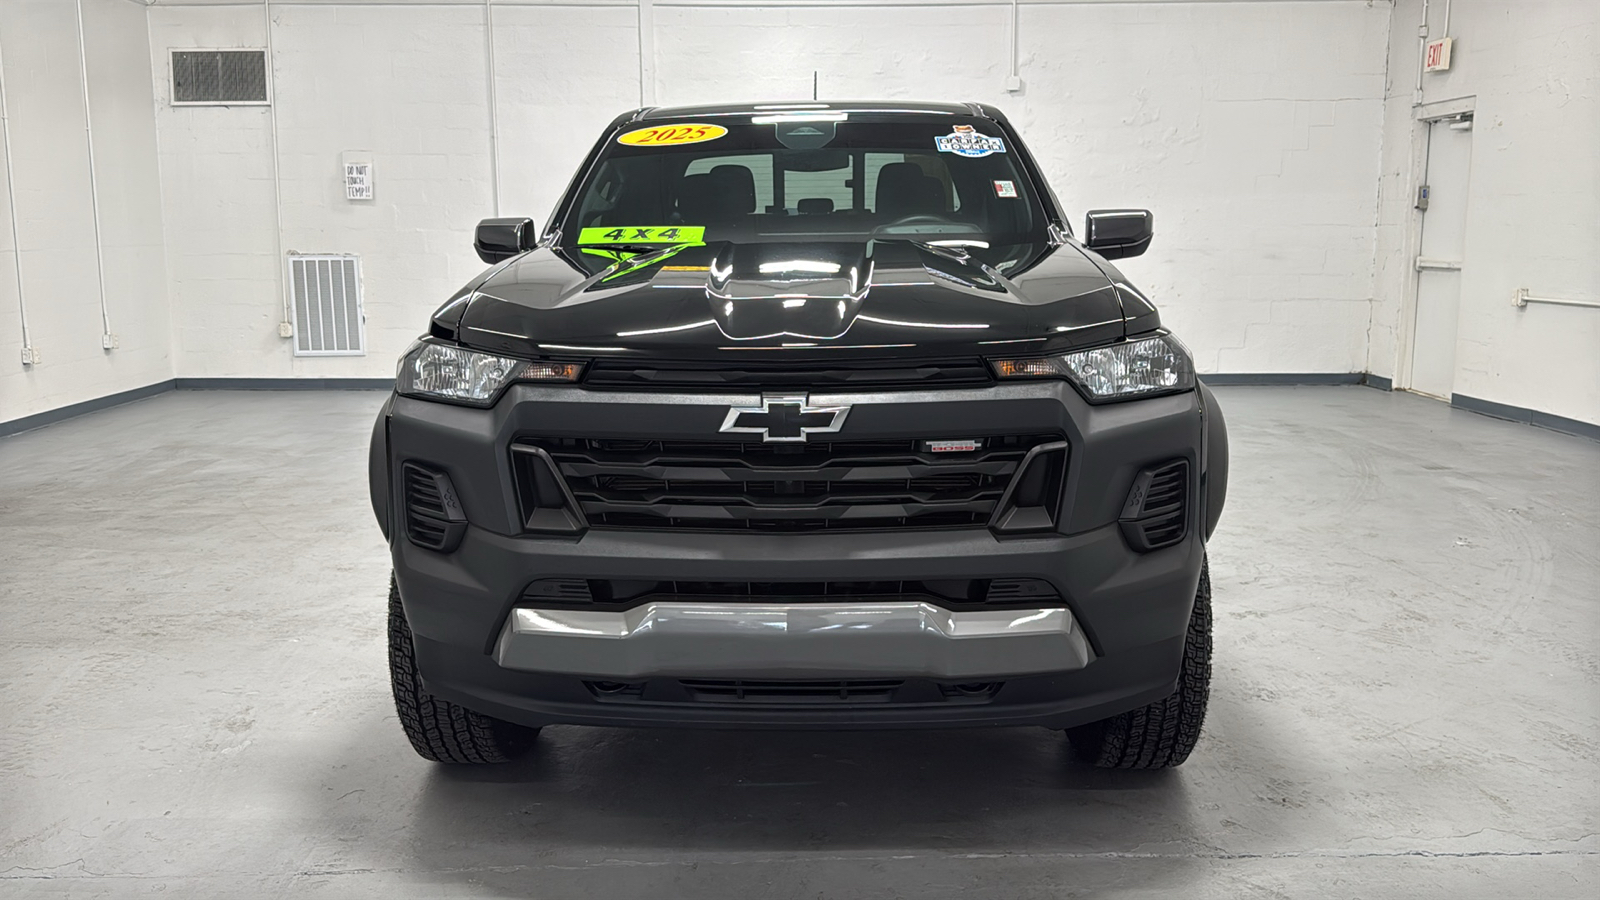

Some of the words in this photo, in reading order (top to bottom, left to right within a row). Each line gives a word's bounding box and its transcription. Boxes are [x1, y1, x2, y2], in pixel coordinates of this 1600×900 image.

[1427, 43, 1443, 67] EXIT
[637, 126, 712, 143] 2025
[347, 165, 354, 175] DO
[355, 165, 368, 176] NOT
[347, 176, 364, 185] TOUCH
